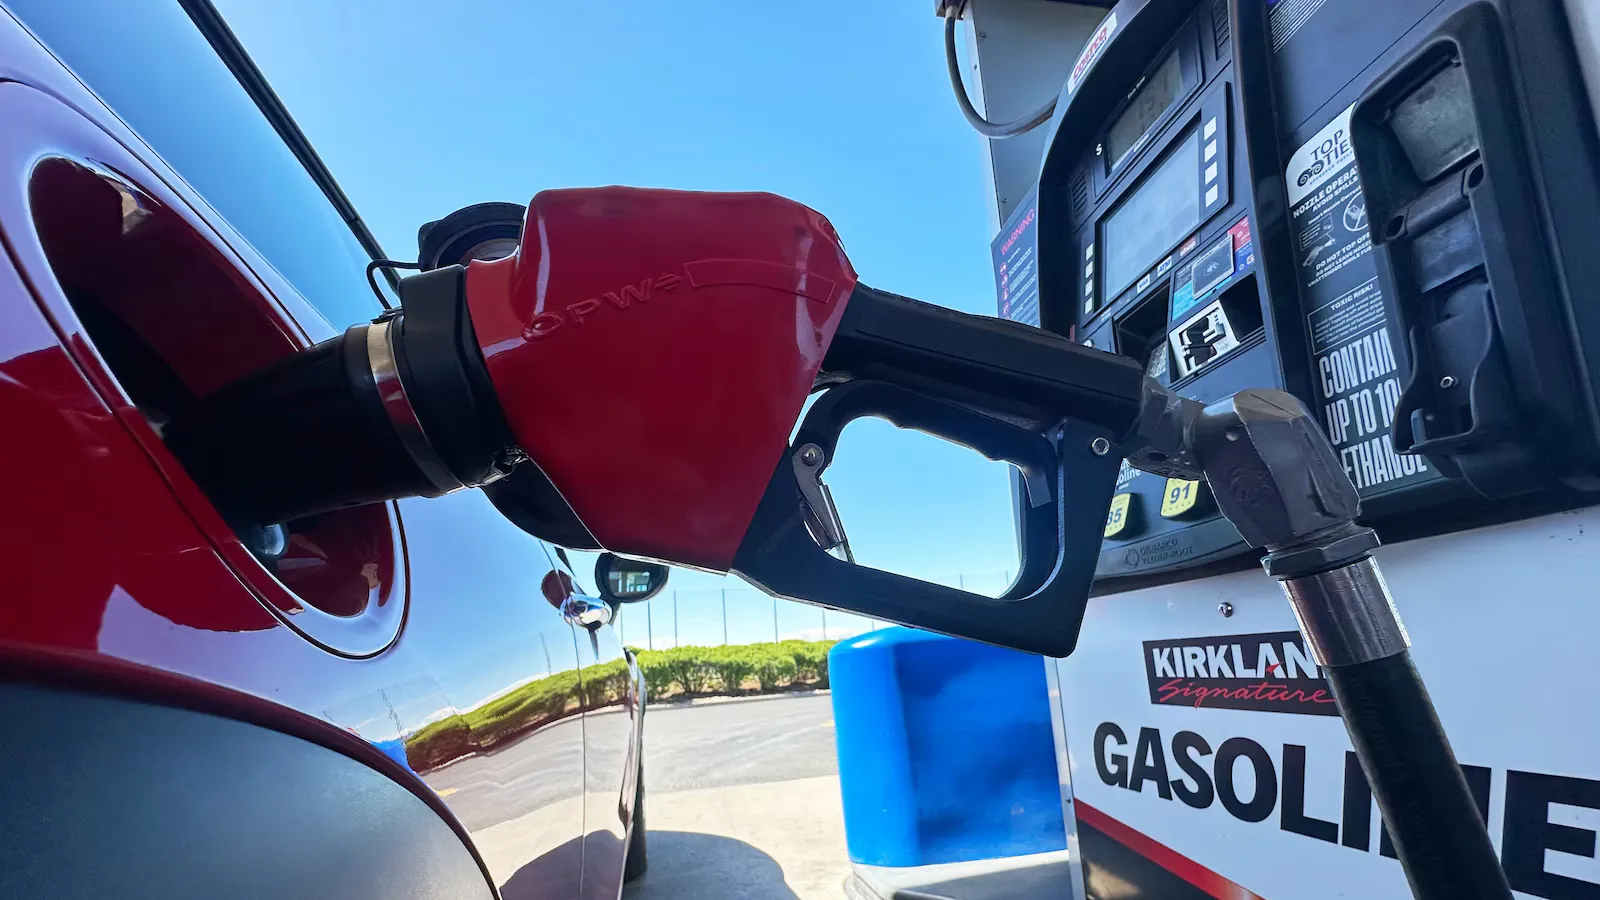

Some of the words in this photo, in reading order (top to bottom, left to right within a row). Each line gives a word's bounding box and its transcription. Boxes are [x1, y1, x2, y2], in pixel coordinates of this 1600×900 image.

[1096, 143, 1103, 156] $
[1310, 129, 1344, 161] TOP
[1323, 138, 1350, 165] TIE
[1293, 189, 1325, 219] NOZZLE
[1325, 165, 1358, 195] OPERA
[1312, 193, 1334, 213] AVOID
[1333, 175, 1359, 197] SPILLS
[1340, 184, 1362, 203] Correct
[1001, 208, 1035, 256] WARNING
[1315, 260, 1326, 271] DO
[1326, 250, 1341, 264] NOT
[1341, 240, 1356, 254] TOP
[522, 277, 653, 341] OPW
[1330, 295, 1353, 311] TOXIC
[1353, 283, 1374, 299] RISK!
[1319, 327, 1397, 399] CONTAIN
[1325, 398, 1350, 446] UP
[1349, 388, 1377, 437] TO
[1375, 377, 1402, 429] 10
[1170, 482, 1191, 505] 91
[1152, 641, 1327, 679] KIRKLAN
[1157, 677, 1337, 710] Signature
